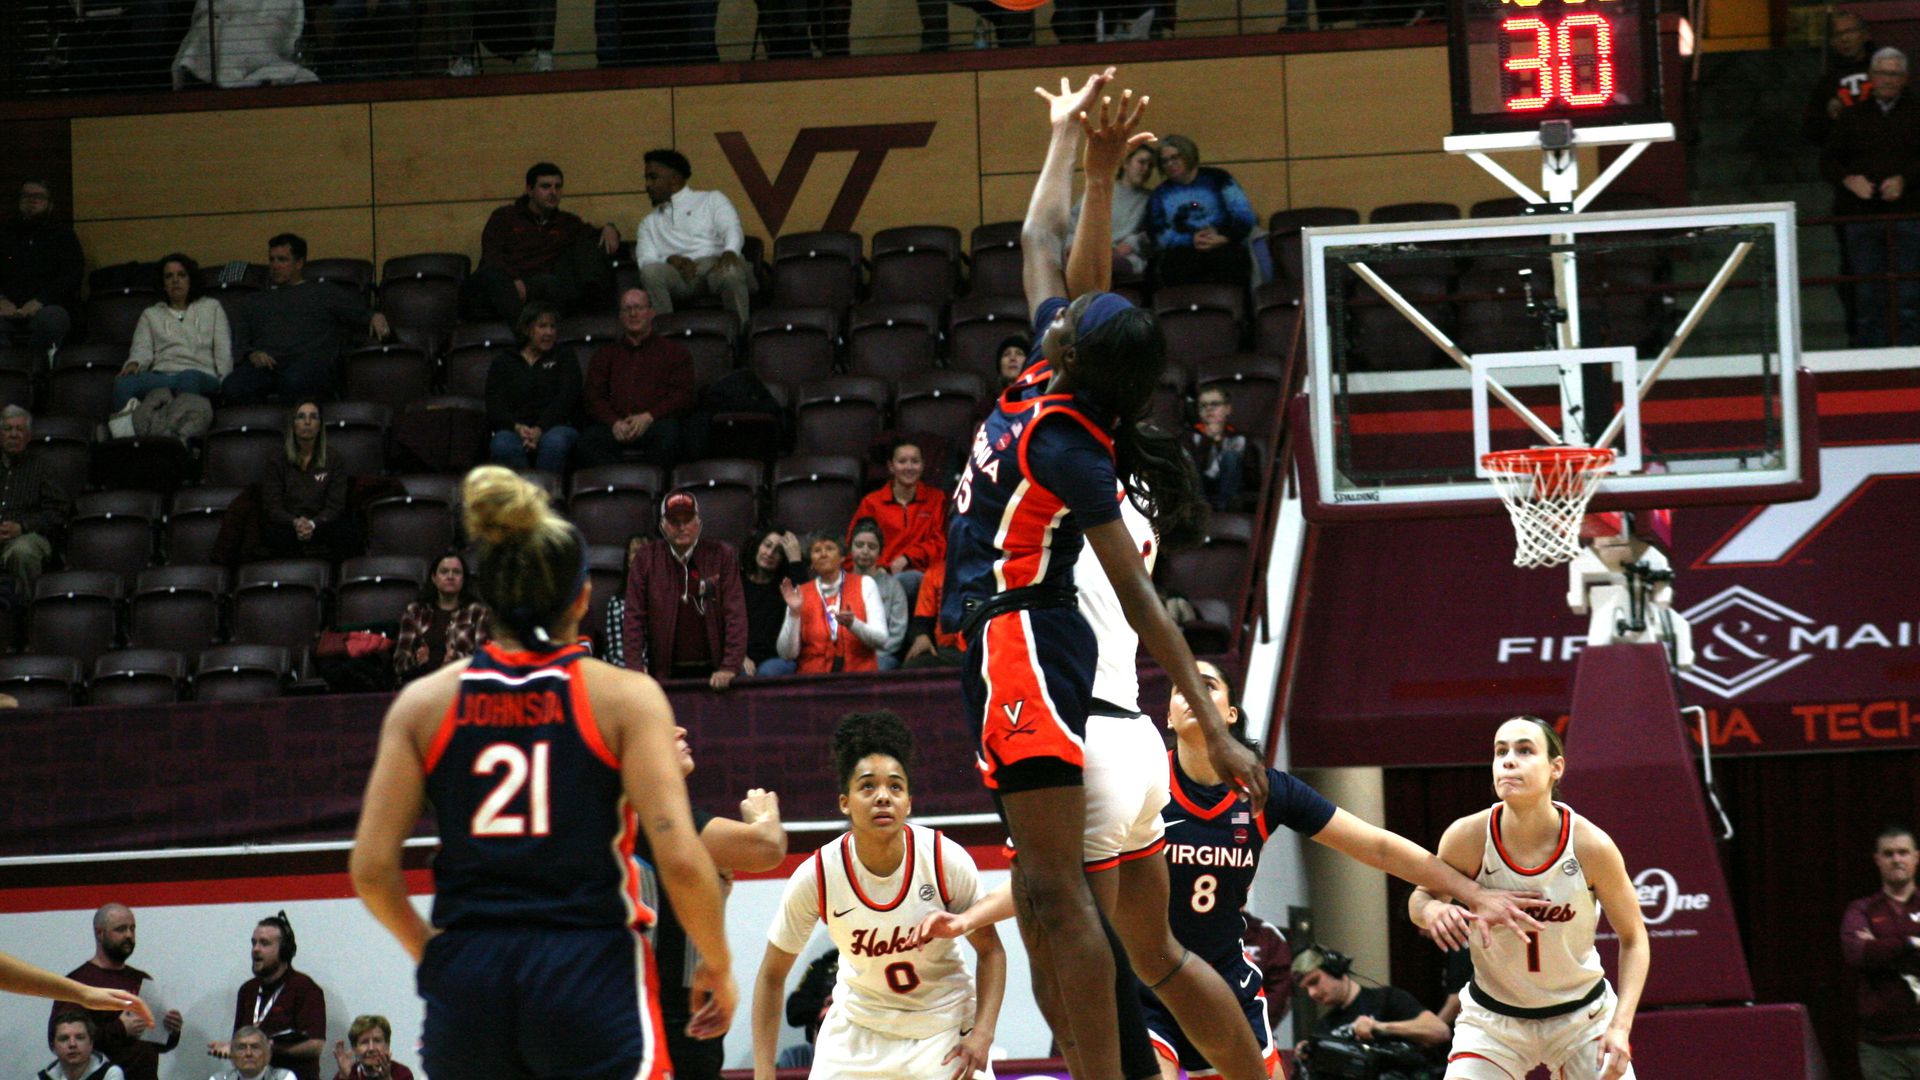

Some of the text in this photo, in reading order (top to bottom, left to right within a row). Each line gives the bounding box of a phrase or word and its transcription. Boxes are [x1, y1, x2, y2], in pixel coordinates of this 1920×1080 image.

[1502, 13, 1614, 111] 30
[714, 121, 938, 240] VT
[1788, 621, 1920, 651] MAI
[472, 741, 551, 836] 21
[1190, 873, 1218, 914] 8
[1525, 930, 1541, 973] 1
[884, 961, 921, 995] 0
